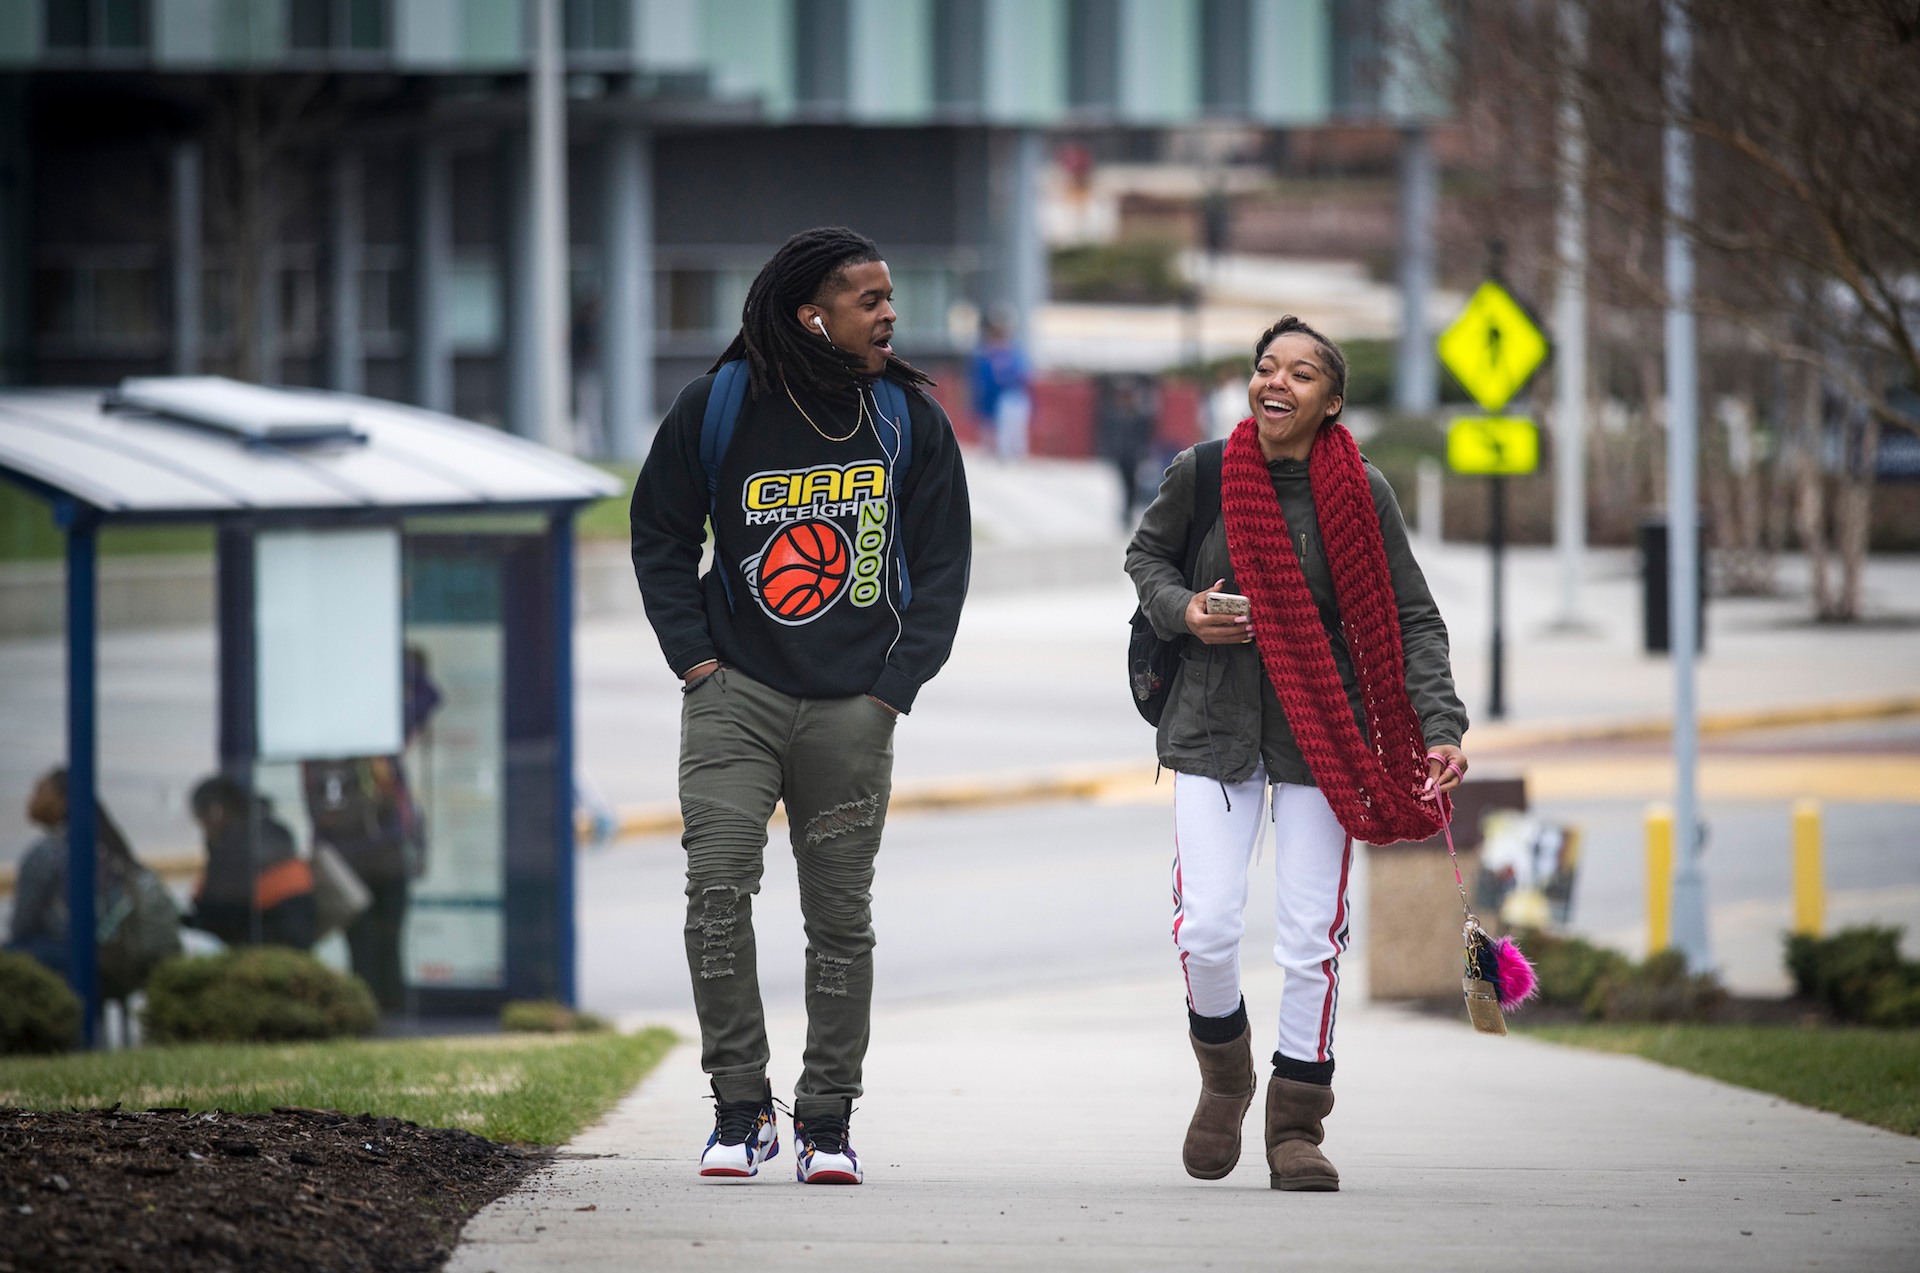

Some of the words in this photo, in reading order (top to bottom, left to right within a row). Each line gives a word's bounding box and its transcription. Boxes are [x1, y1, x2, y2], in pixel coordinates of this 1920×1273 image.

[745, 464, 887, 511] CIAA
[745, 501, 859, 526] RALEIGH
[852, 501, 887, 607] 2000
